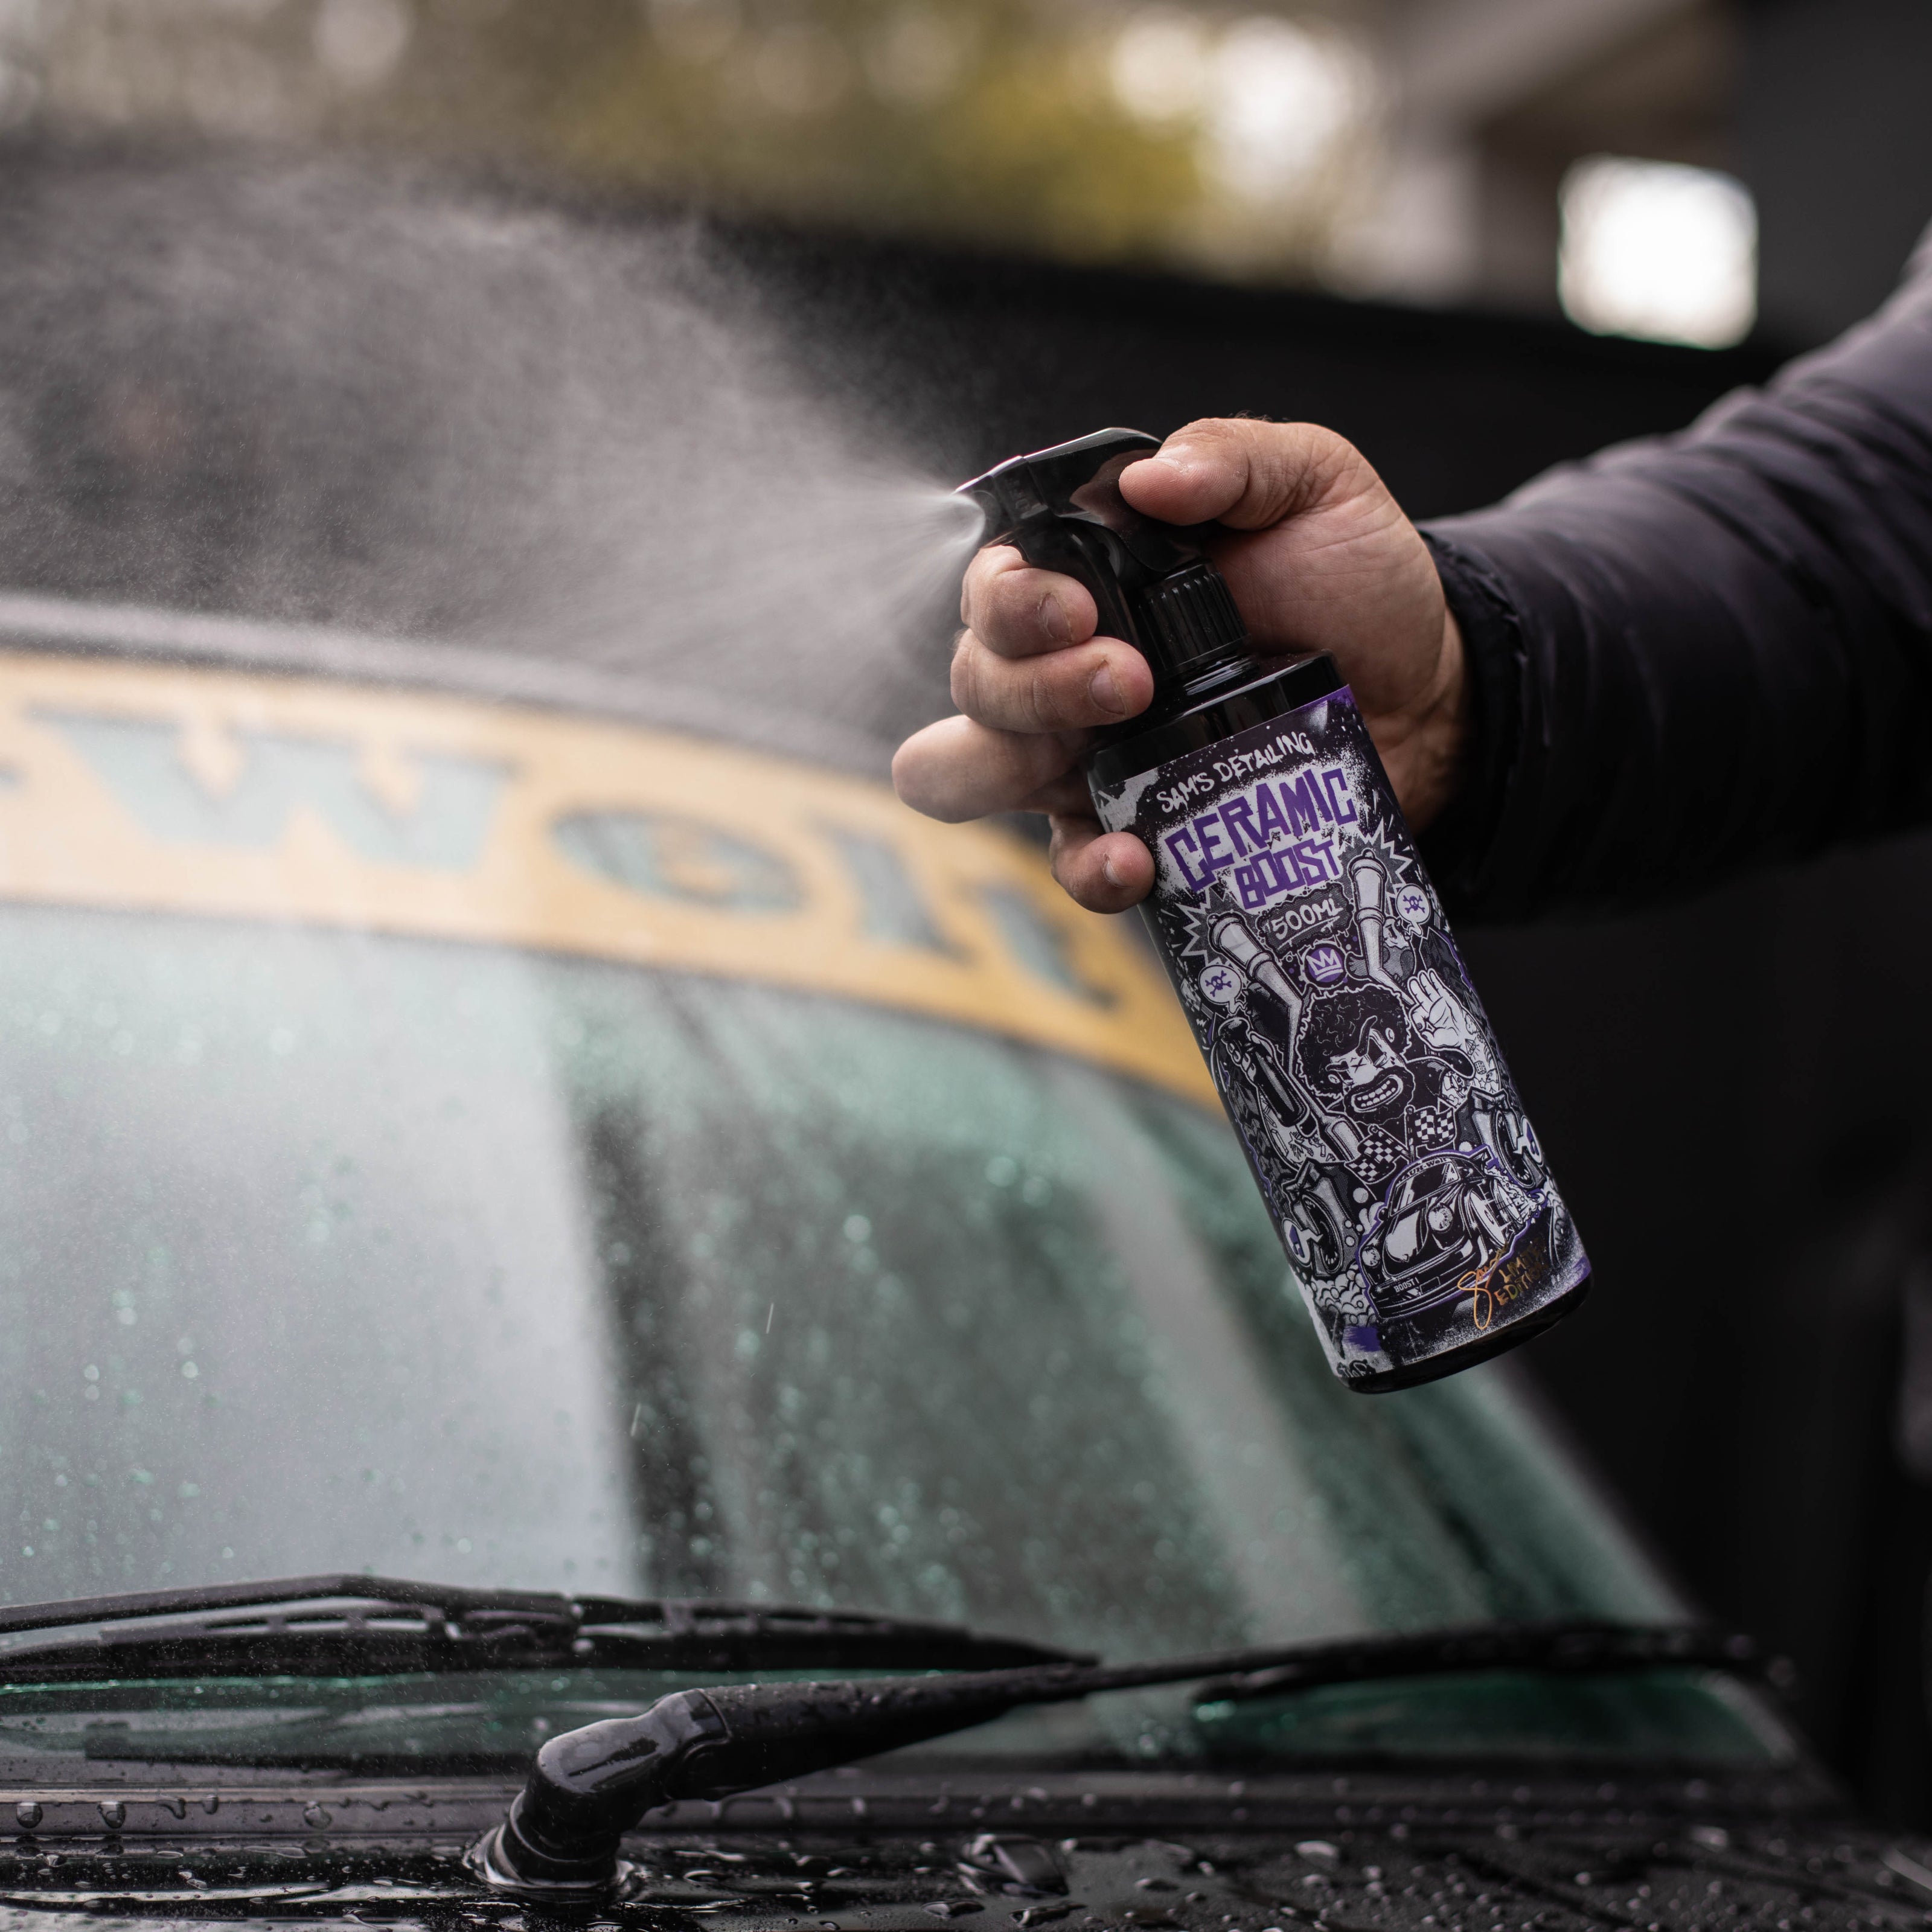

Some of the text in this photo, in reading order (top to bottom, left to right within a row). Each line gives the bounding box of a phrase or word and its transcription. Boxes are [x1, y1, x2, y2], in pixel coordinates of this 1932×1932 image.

[1156, 731, 1317, 813] SAM'S DETAILING
[1163, 767, 1358, 892] CERAMIC
[1233, 838, 1340, 910] BOOST
[1270, 898, 1343, 940] 500ML
[1393, 1278, 1415, 1293] BOOST
